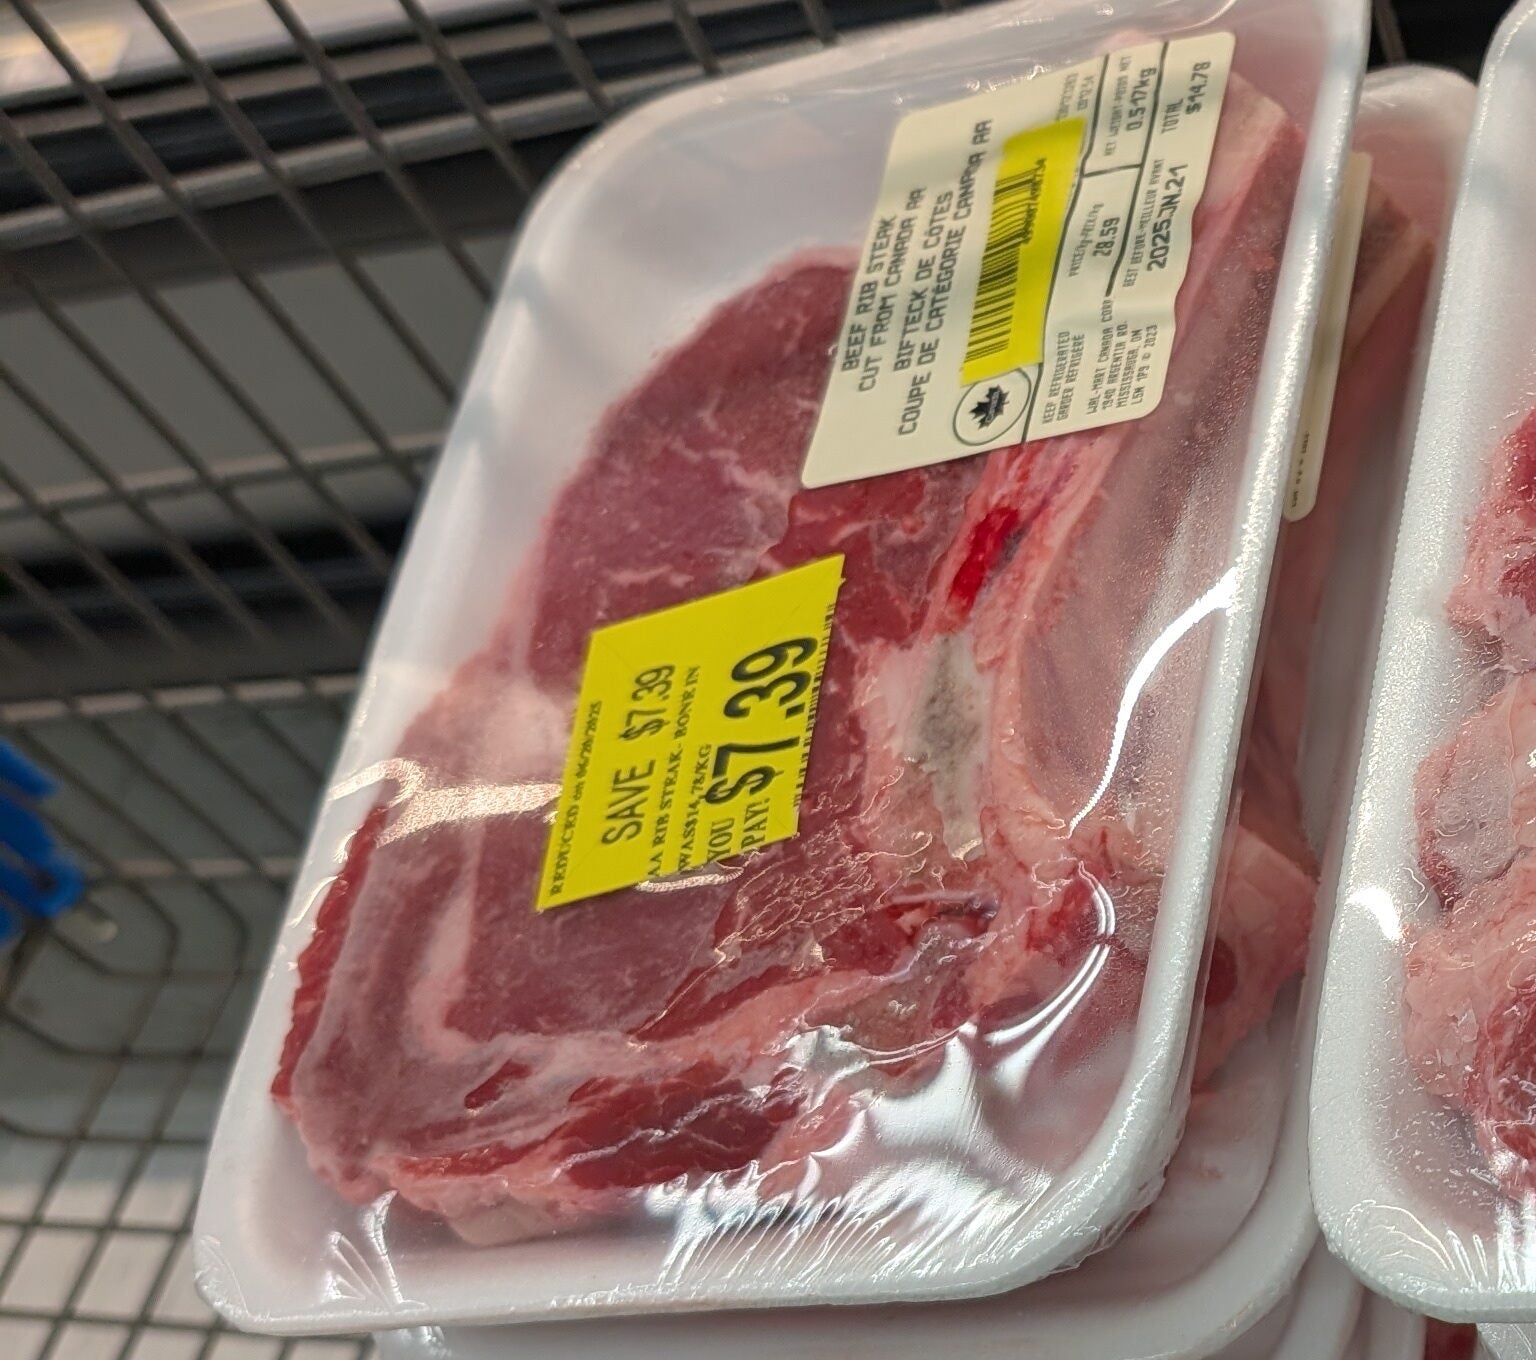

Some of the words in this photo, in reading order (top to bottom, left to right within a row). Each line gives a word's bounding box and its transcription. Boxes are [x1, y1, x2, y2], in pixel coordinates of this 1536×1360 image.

[1125, 67, 1157, 132] 0.517kg
[1185, 62, 1211, 115] $14.78
[971, 120, 991, 146] AA
[1161, 97, 1184, 133] TOTAL
[905, 188, 926, 211] AA
[922, 190, 954, 250] CÔTES
[1146, 164, 1188, 272] 2025.JN.21
[865, 216, 897, 274] STEAK
[884, 217, 915, 288] CANADA
[1091, 217, 1121, 257] 28.59
[914, 255, 936, 282] DE
[924, 227, 966, 332] CATÉGORIE
[855, 280, 878, 316] RIB
[869, 294, 897, 347] FROM
[841, 324, 867, 371] BEEF
[893, 287, 929, 371] BIFTECK
[916, 338, 940, 366] DE
[1130, 328, 1143, 343] ON
[858, 355, 882, 392] CUT
[1047, 330, 1071, 398] REFRIGERATED
[1086, 367, 1107, 415] WAL-MART
[1097, 326, 1114, 363] CANADA
[1106, 341, 1127, 385] ARGENTIA
[1131, 386, 1145, 405] L5N
[1143, 323, 1158, 349] 2023
[898, 371, 931, 436] COUPE
[1041, 401, 1057, 425] KEEP
[1056, 387, 1074, 422] GARDER
[1101, 387, 1117, 410] 1940
[685, 666, 700, 687] IN
[618, 664, 676, 741] $7.39
[673, 688, 696, 740] BONE
[699, 637, 818, 805] $7.39
[600, 759, 656, 845] SAVE
[740, 798, 770, 849] PAY!
[549, 804, 580, 896] REDUCED
[572, 781, 585, 801] on
[652, 813, 670, 848] RIB
[704, 817, 735, 865] YOU
[647, 852, 663, 877] AA
